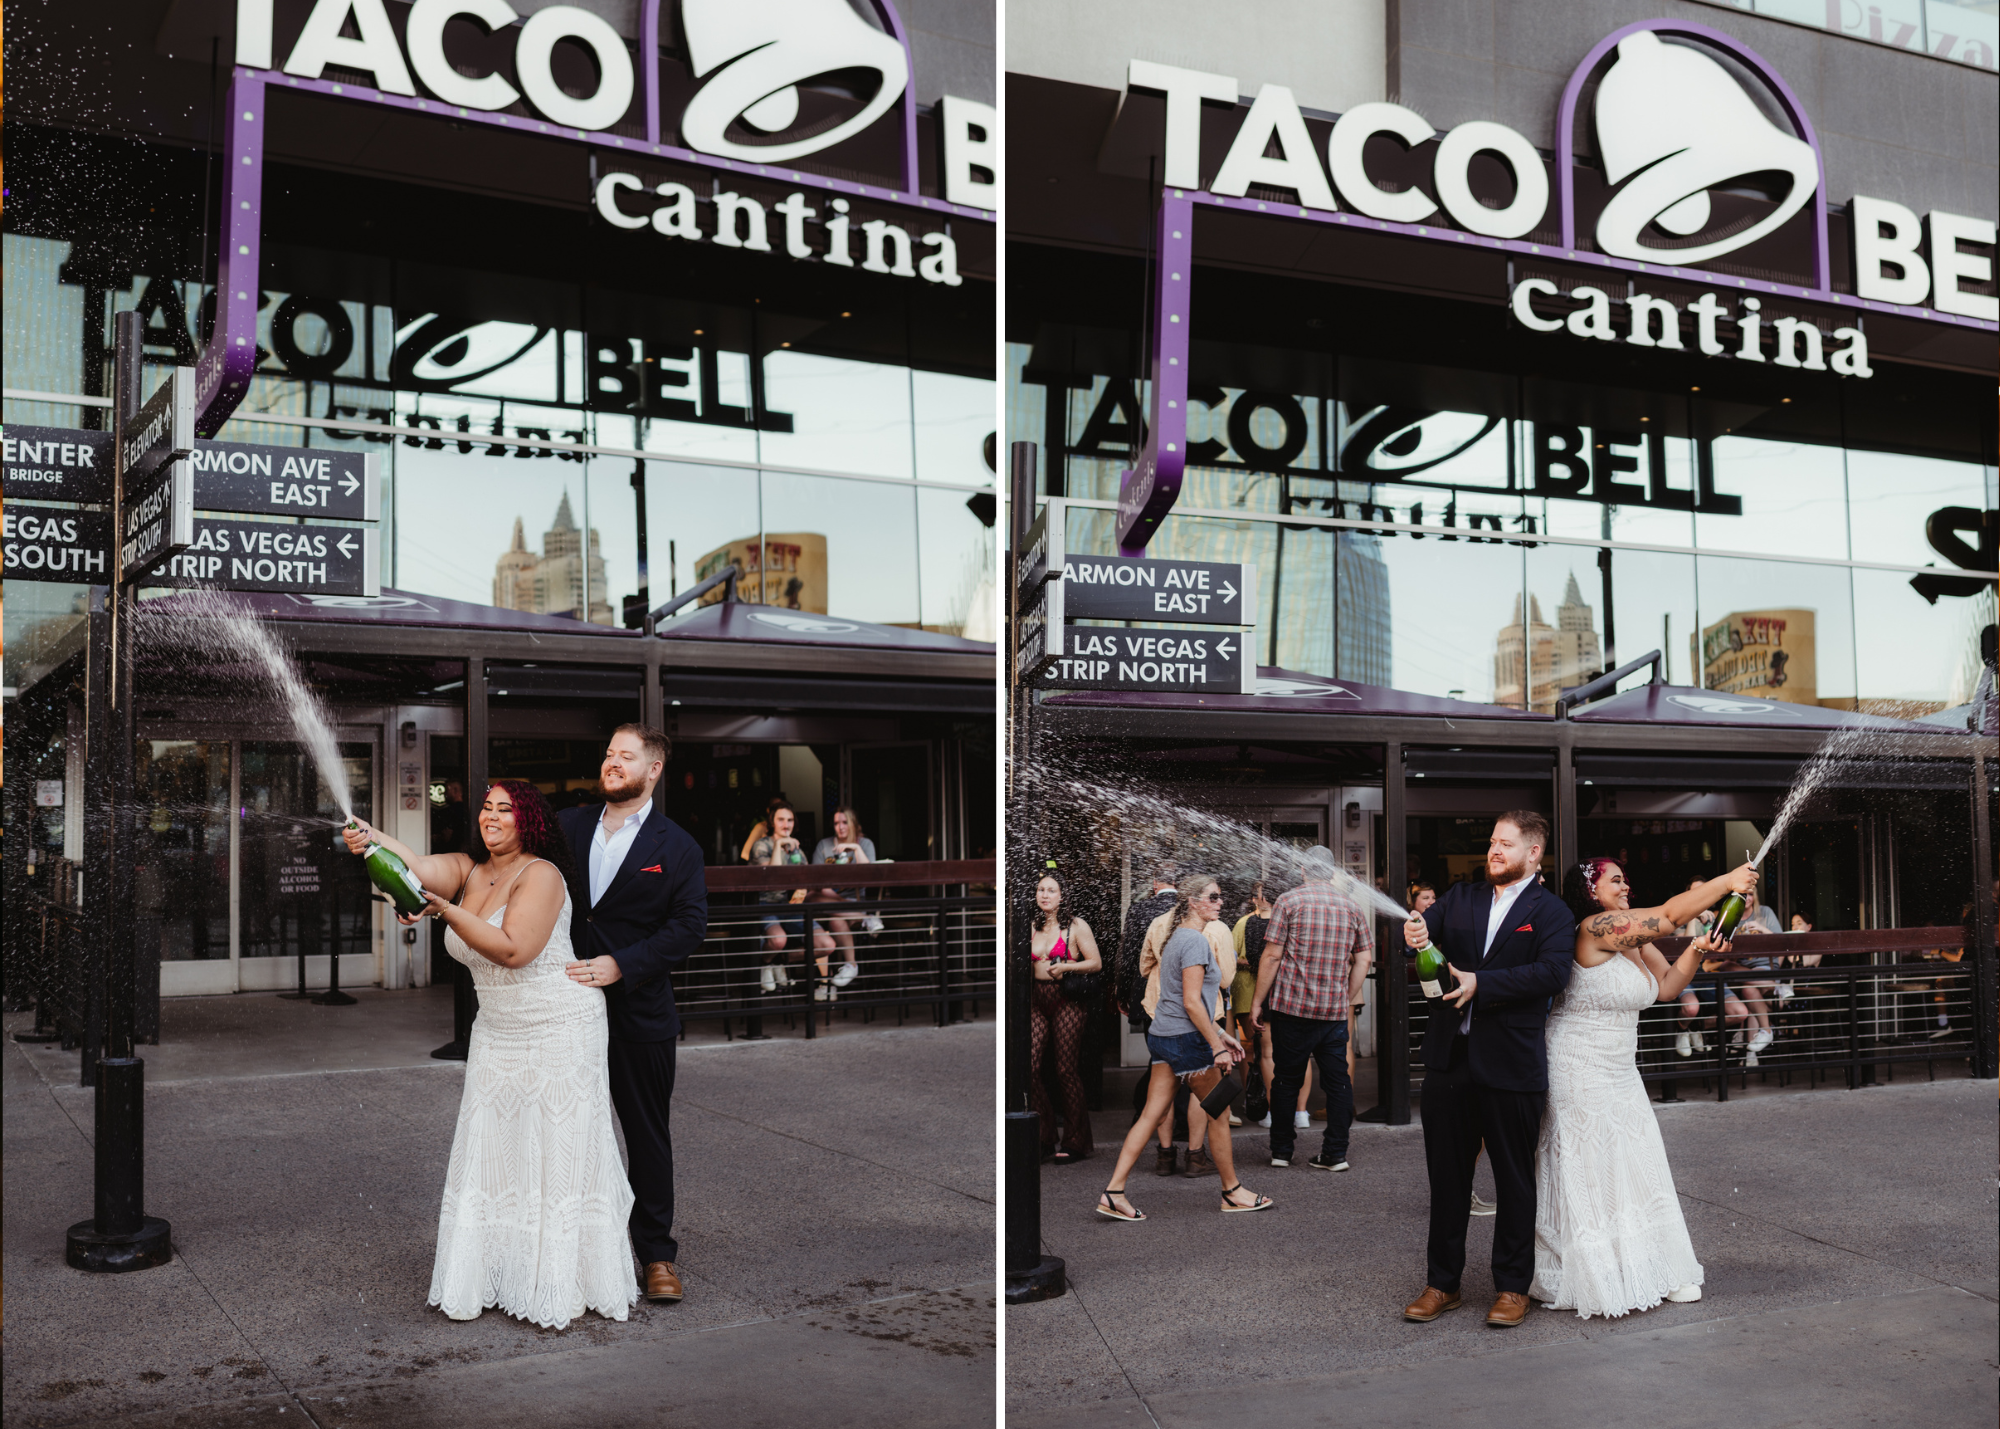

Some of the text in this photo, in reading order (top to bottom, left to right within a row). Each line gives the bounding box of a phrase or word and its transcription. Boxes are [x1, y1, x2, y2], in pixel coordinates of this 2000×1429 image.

[1127, 58, 1549, 239] TACO
[595, 172, 963, 286] cantina
[1512, 278, 1873, 378] cantina
[130, 413, 163, 466] ELEVATOR
[10, 468, 63, 484] BRIDGE
[280, 456, 331, 481] AVE
[271, 481, 331, 507] EAST
[127, 487, 162, 537] LAS VEGAS
[121, 518, 162, 570] STRIP SOUTH
[239, 530, 327, 557] VEGAS
[4, 543, 105, 573] SOUTH
[231, 557, 327, 584] NORTH
[1164, 568, 1210, 590] AVE
[1154, 592, 1211, 614] EAST
[1074, 634, 1207, 660] LAS VEGAS
[1119, 662, 1207, 683] NORTH
[280, 866, 319, 875] OUTSIDE
[293, 857, 307, 865] NO
[279, 875, 322, 884] ALCOHOL
[280, 884, 320, 893] OR FOOD
